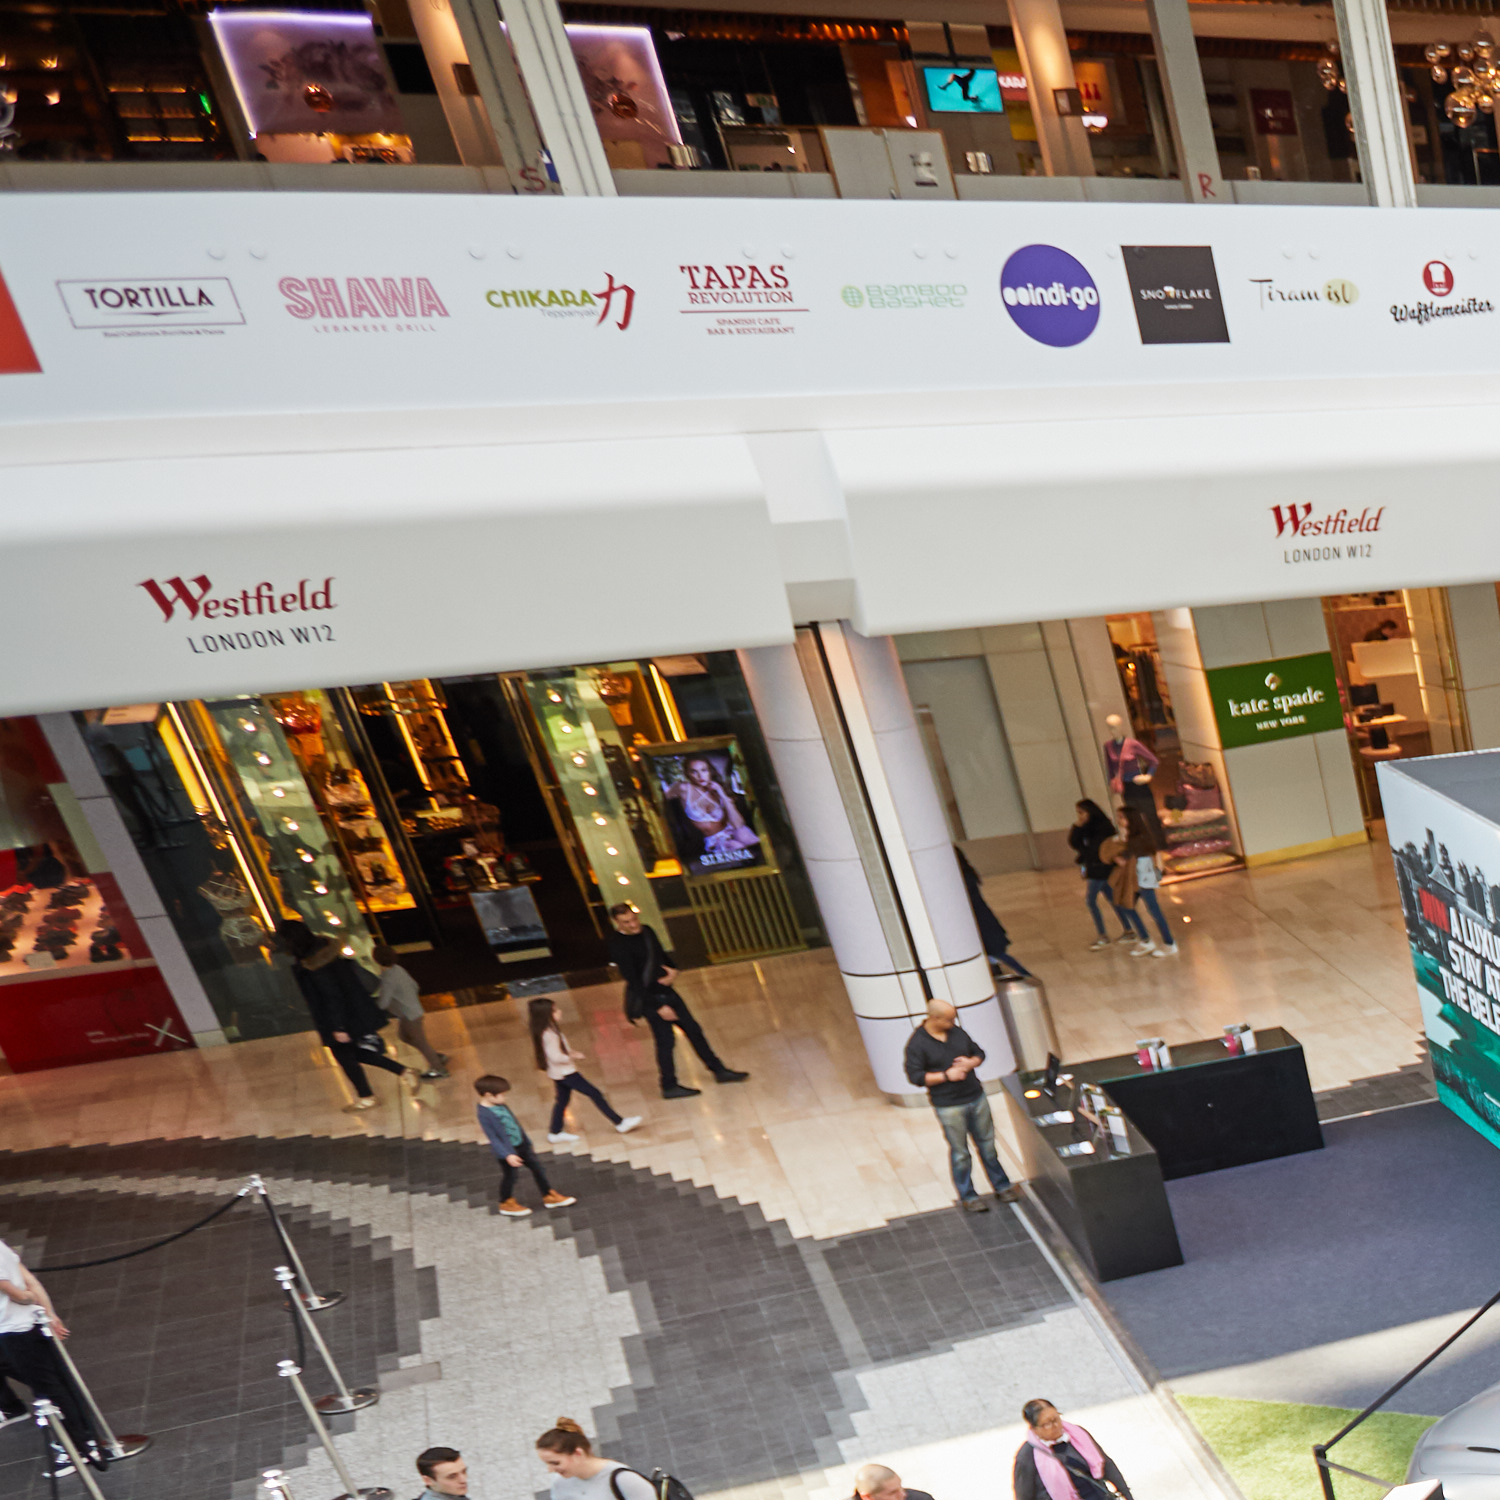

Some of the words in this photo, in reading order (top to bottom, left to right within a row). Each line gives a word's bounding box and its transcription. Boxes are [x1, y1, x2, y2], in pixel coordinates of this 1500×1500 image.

[679, 265, 790, 290] TAPAS
[83, 287, 214, 309] TORTILLA
[278, 275, 451, 320] SHAWA
[485, 290, 598, 309] CHIKARA
[593, 271, 636, 331] 力
[687, 291, 794, 305] REVOLUTION
[1390, 298, 1495, 325] Wafflemeister
[1268, 501, 1386, 539] Westfield
[1284, 546, 1341, 564] LONDON
[1346, 543, 1373, 558] W12
[135, 574, 339, 623] Westfield
[186, 628, 287, 654] LONDON
[289, 624, 337, 644] W12
[1228, 698, 1270, 717] kate
[1273, 686, 1325, 715] spade
[1256, 719, 1279, 731] NEW
[1280, 715, 1307, 727] YORK
[700, 848, 755, 866] SIENNA
[1450, 907, 1463, 942] A
[1448, 940, 1483, 989] STAY
[1438, 965, 1470, 1014] THE
